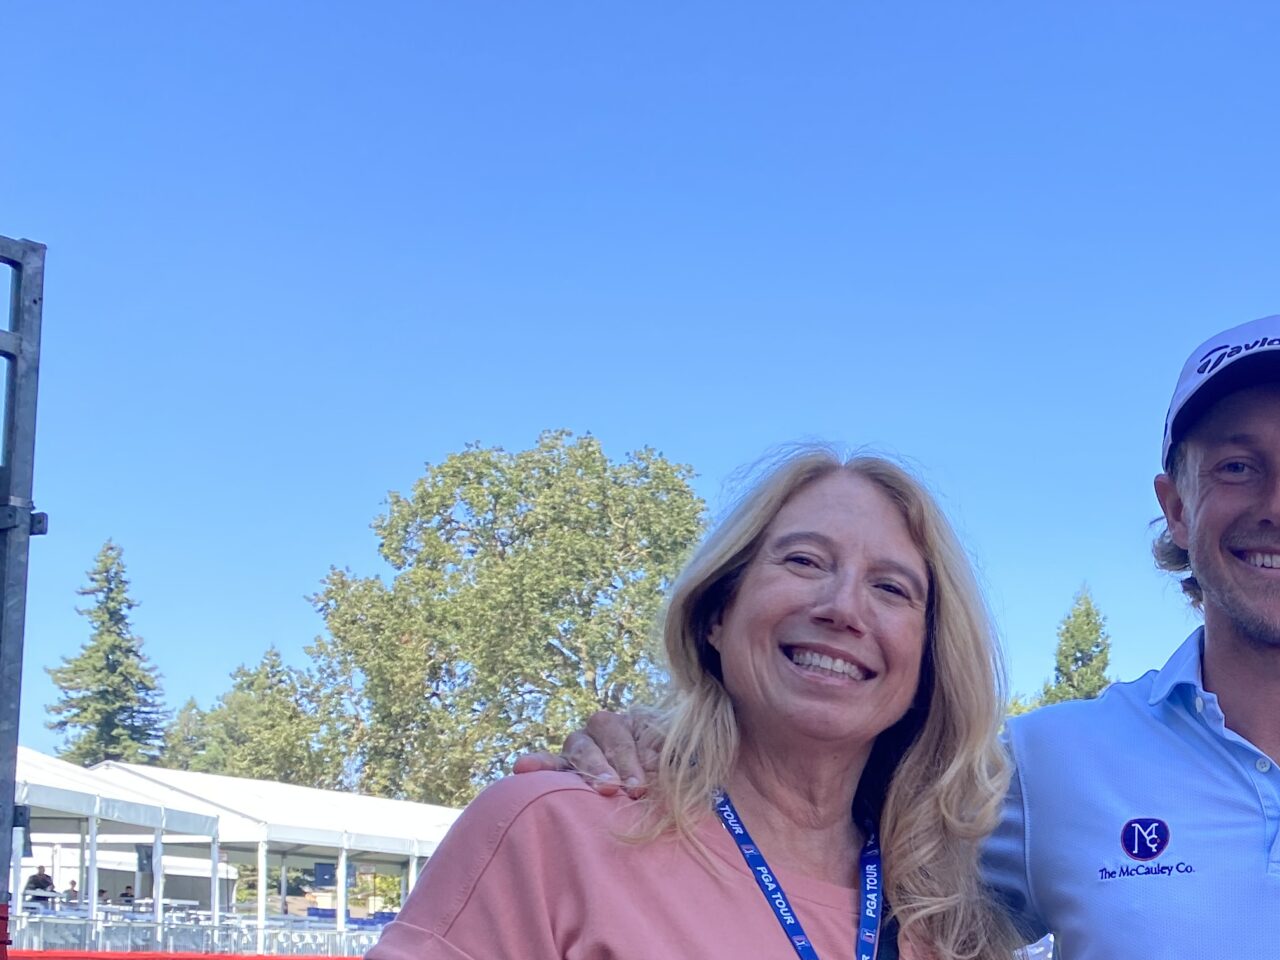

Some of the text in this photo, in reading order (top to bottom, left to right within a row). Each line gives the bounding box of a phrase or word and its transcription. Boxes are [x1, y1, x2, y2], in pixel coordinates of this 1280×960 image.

[720, 805, 744, 834] TOUR
[866, 864, 878, 890] TOUR
[1099, 862, 1196, 880] The McCauley Co.
[756, 866, 795, 925] PGA TOUR
[866, 893, 878, 918] PGA
